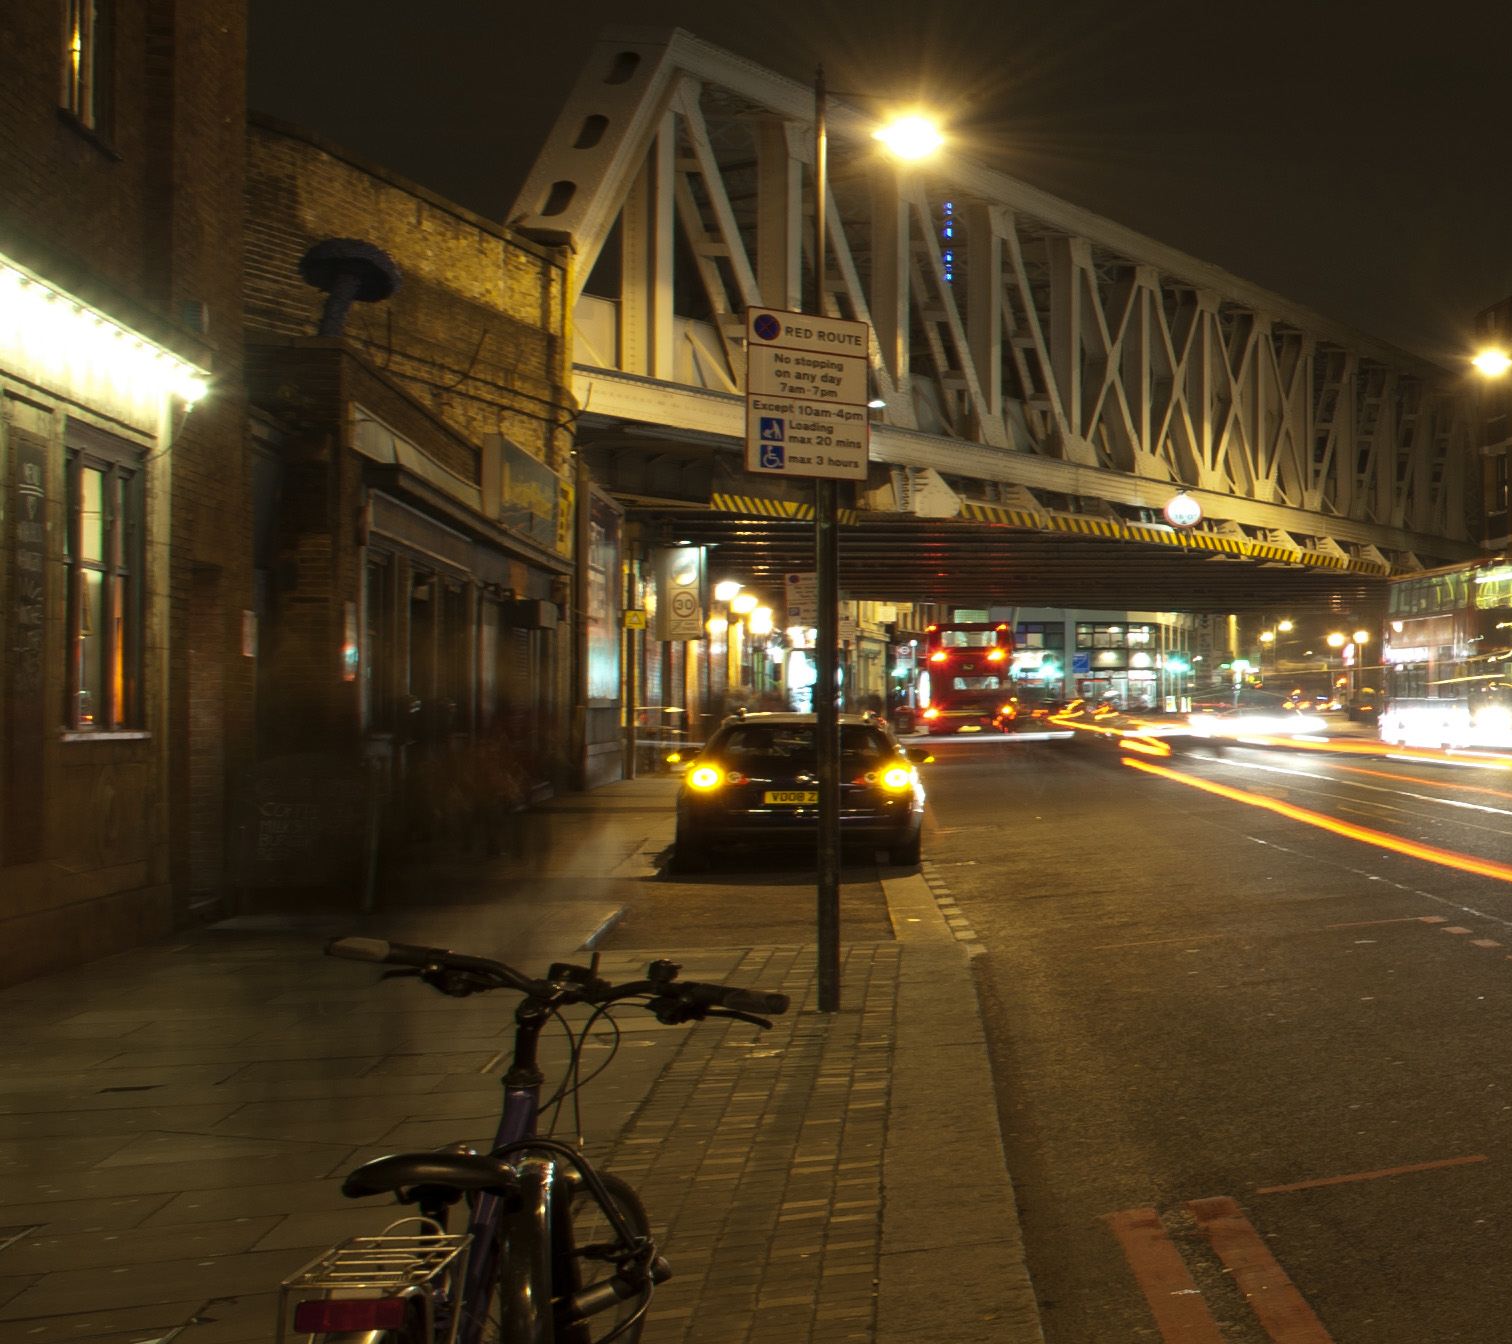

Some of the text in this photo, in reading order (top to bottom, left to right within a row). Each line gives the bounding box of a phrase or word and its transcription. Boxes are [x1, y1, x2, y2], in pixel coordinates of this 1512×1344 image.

[785, 326, 863, 346] RED ROUTE
[774, 353, 844, 372] No stopping
[774, 370, 843, 386] on any day
[752, 399, 864, 422] Except 10am-4pm
[788, 420, 834, 435] Loading
[788, 435, 862, 449] max 20 mins
[788, 454, 860, 469] max 3 hours
[675, 599, 694, 610] 30
